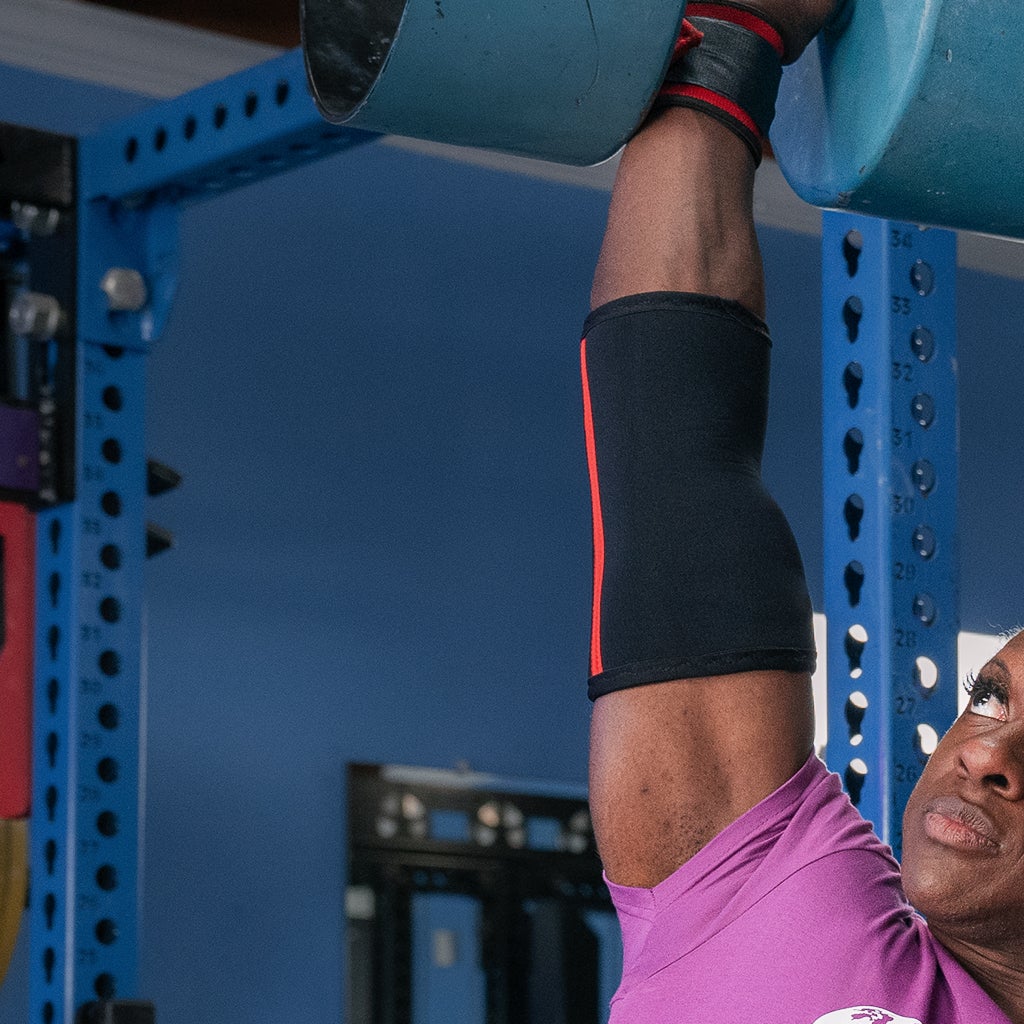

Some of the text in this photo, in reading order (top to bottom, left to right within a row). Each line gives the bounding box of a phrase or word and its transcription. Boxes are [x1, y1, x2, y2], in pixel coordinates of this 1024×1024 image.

[891, 229, 912, 248] 34
[891, 295, 911, 315] 33
[892, 361, 913, 382] 32
[892, 427, 912, 448] 31
[893, 494, 914, 513] 30
[894, 561, 916, 581] 29
[895, 628, 916, 648] 28
[895, 695, 917, 715] 27
[895, 763, 918, 783] 26
